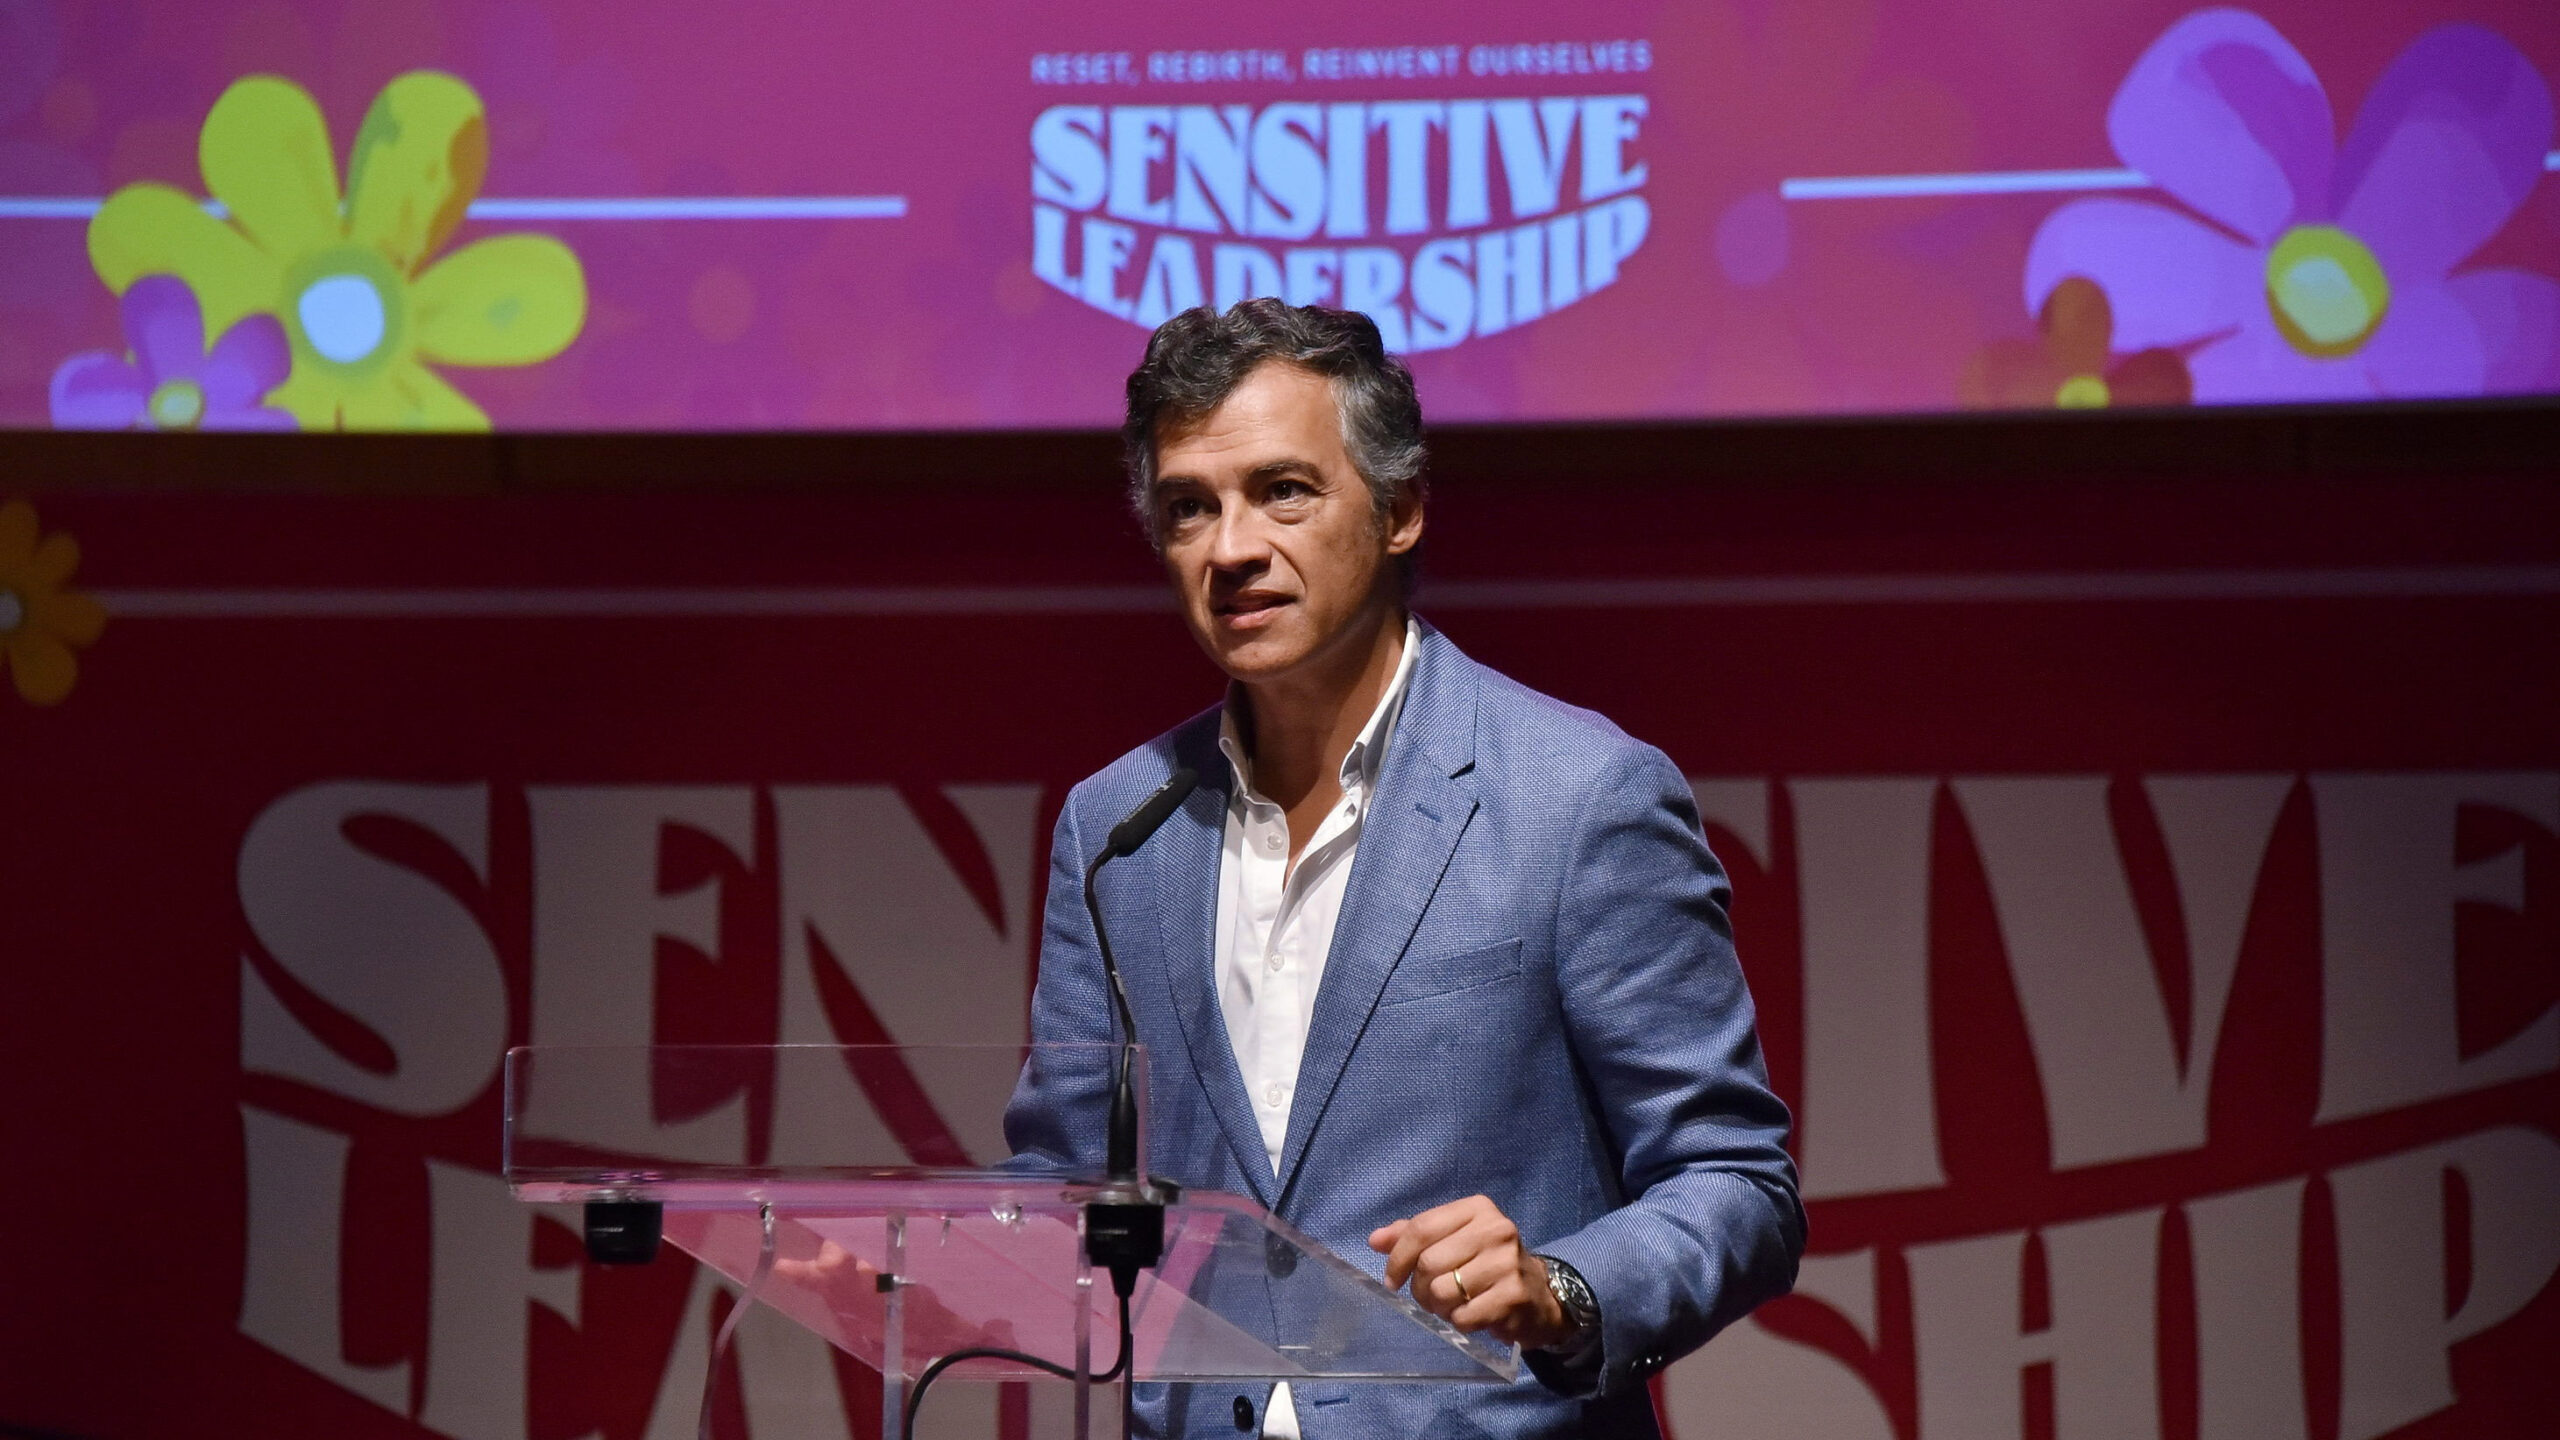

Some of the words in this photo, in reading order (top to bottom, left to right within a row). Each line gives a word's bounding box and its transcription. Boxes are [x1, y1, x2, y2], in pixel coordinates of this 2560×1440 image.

[1031, 53, 1140, 85] RESET,
[1147, 50, 1296, 84] REBIRTH,
[1303, 47, 1461, 80] REINVENT
[1467, 40, 1653, 77] OURSELVES
[1030, 94, 1650, 240] SENSITIVE
[237, 770, 2560, 1200] SENIVE
